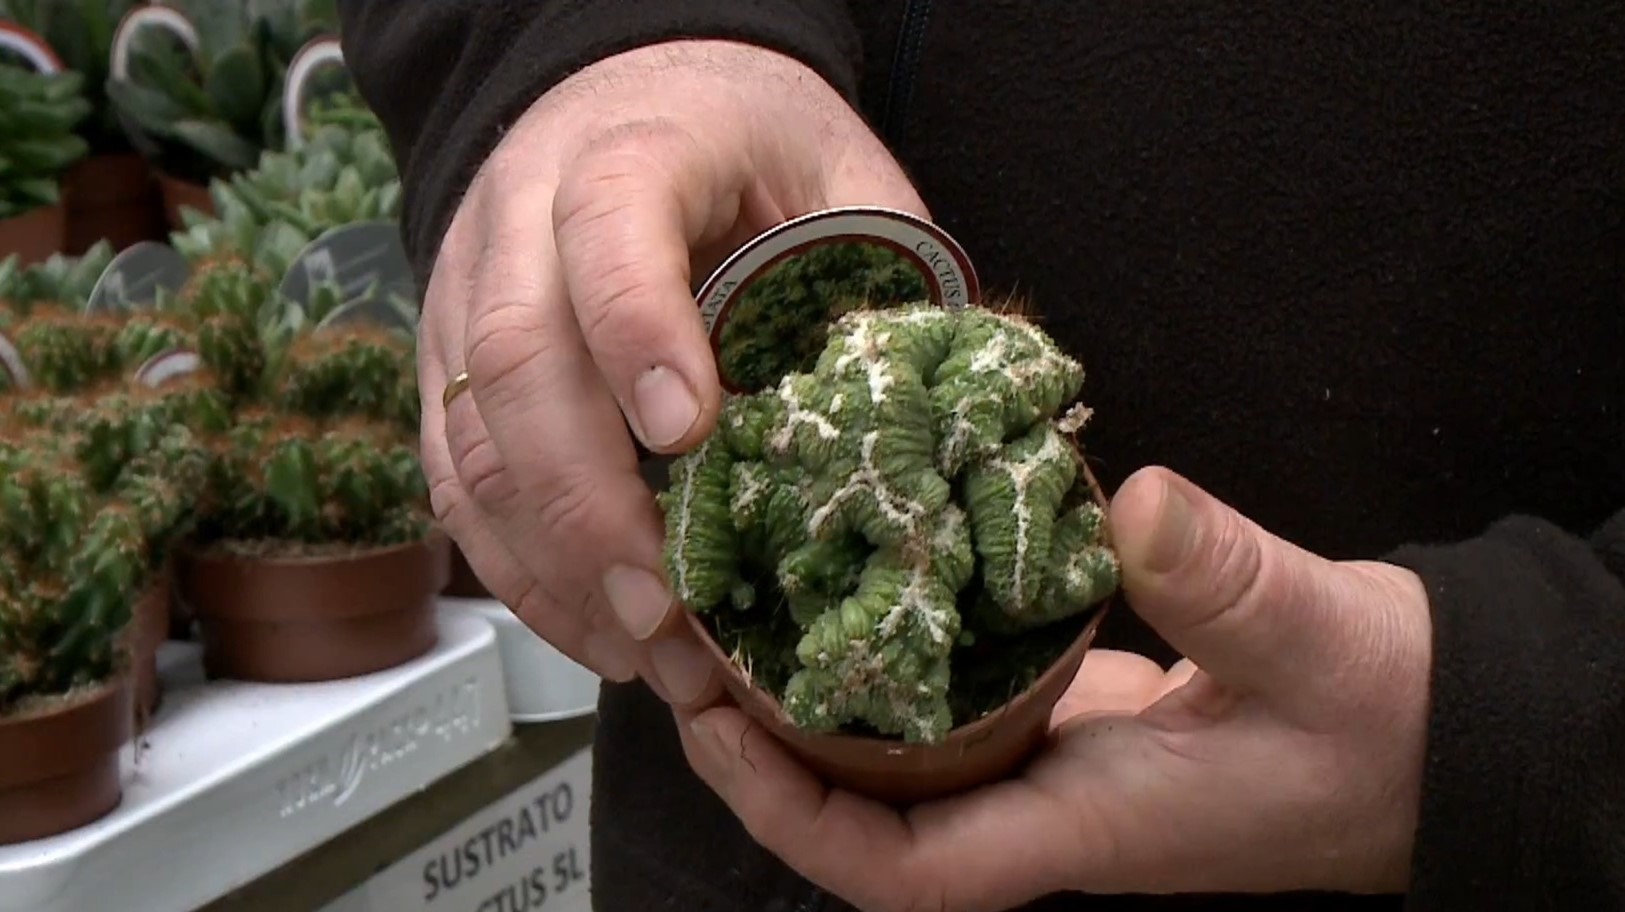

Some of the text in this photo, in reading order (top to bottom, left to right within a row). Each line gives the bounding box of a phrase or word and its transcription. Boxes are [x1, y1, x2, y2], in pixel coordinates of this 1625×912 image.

[916, 241, 961, 298] CACTUS
[423, 781, 573, 901] SUSTRATO
[553, 847, 584, 893] 5L
